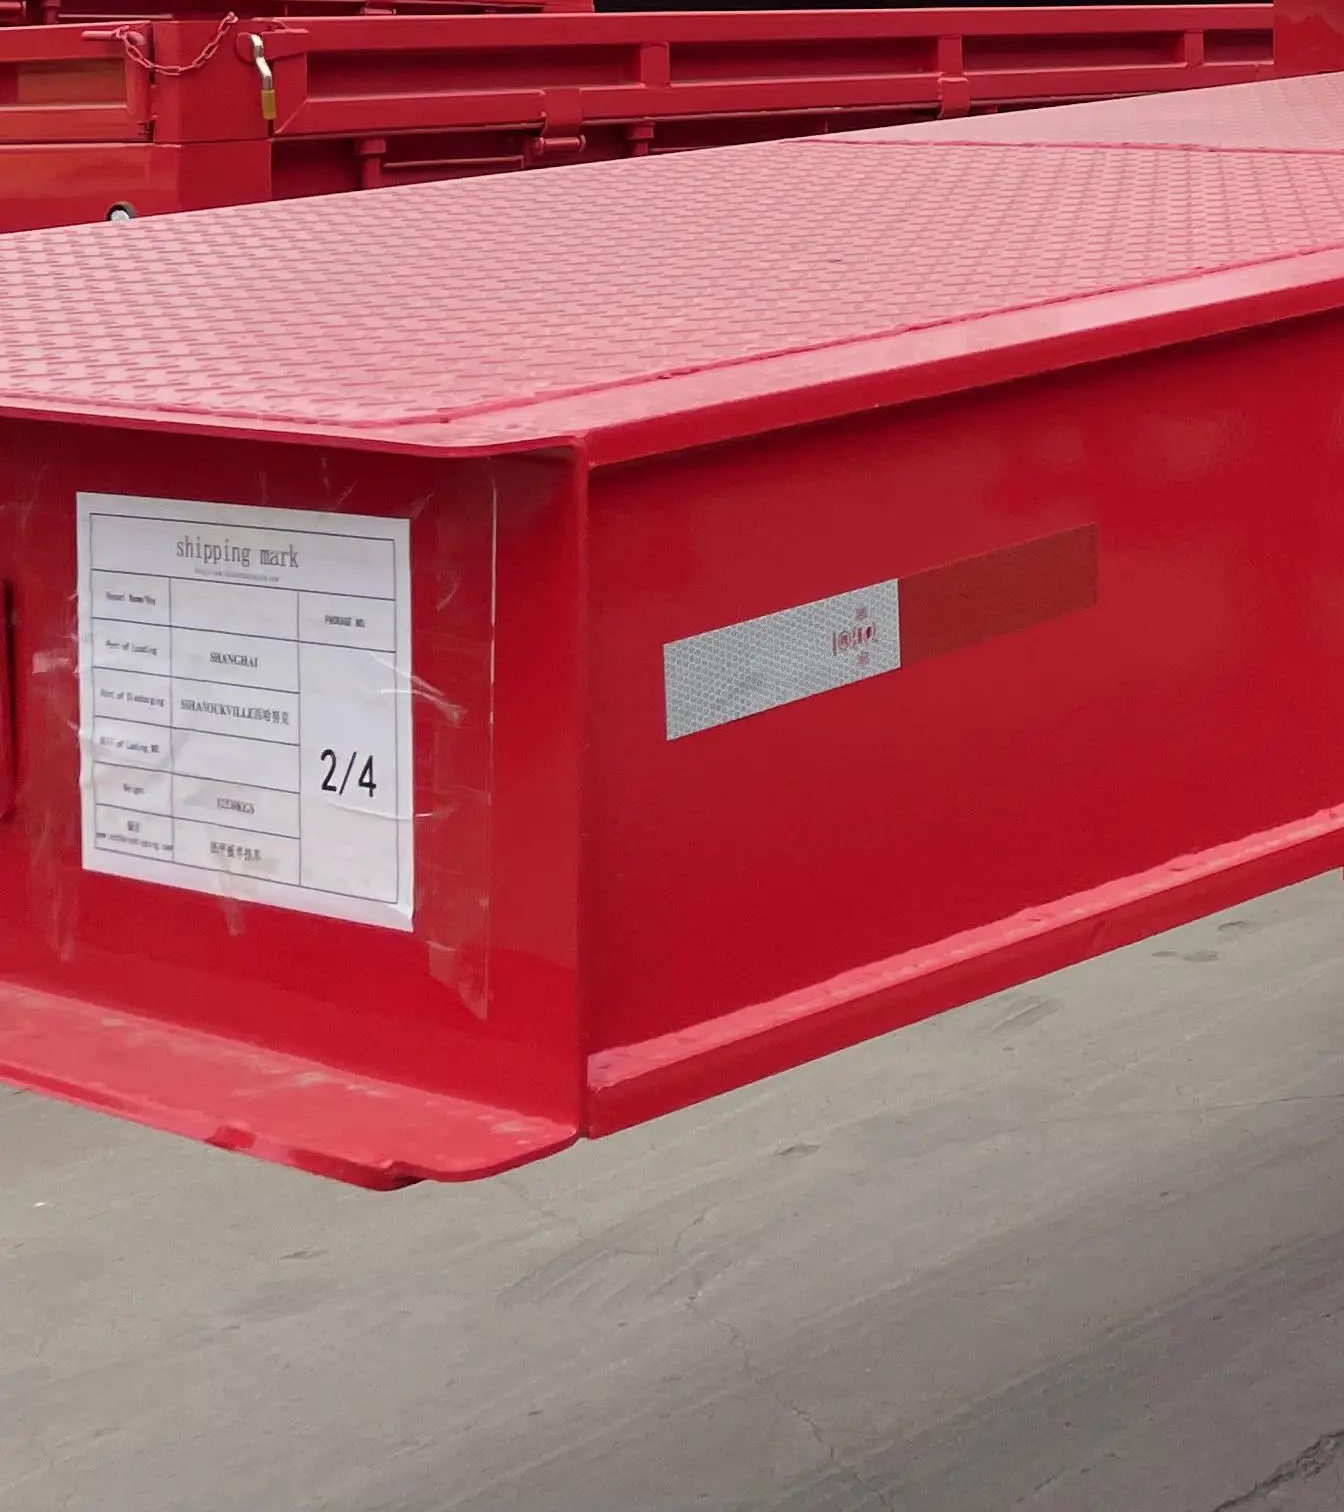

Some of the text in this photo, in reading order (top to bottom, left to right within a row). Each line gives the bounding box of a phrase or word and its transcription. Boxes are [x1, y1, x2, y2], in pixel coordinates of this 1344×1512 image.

[176, 535, 299, 568] shipping mark
[210, 651, 259, 669] SHANGHAI
[320, 749, 377, 798] 2/4
